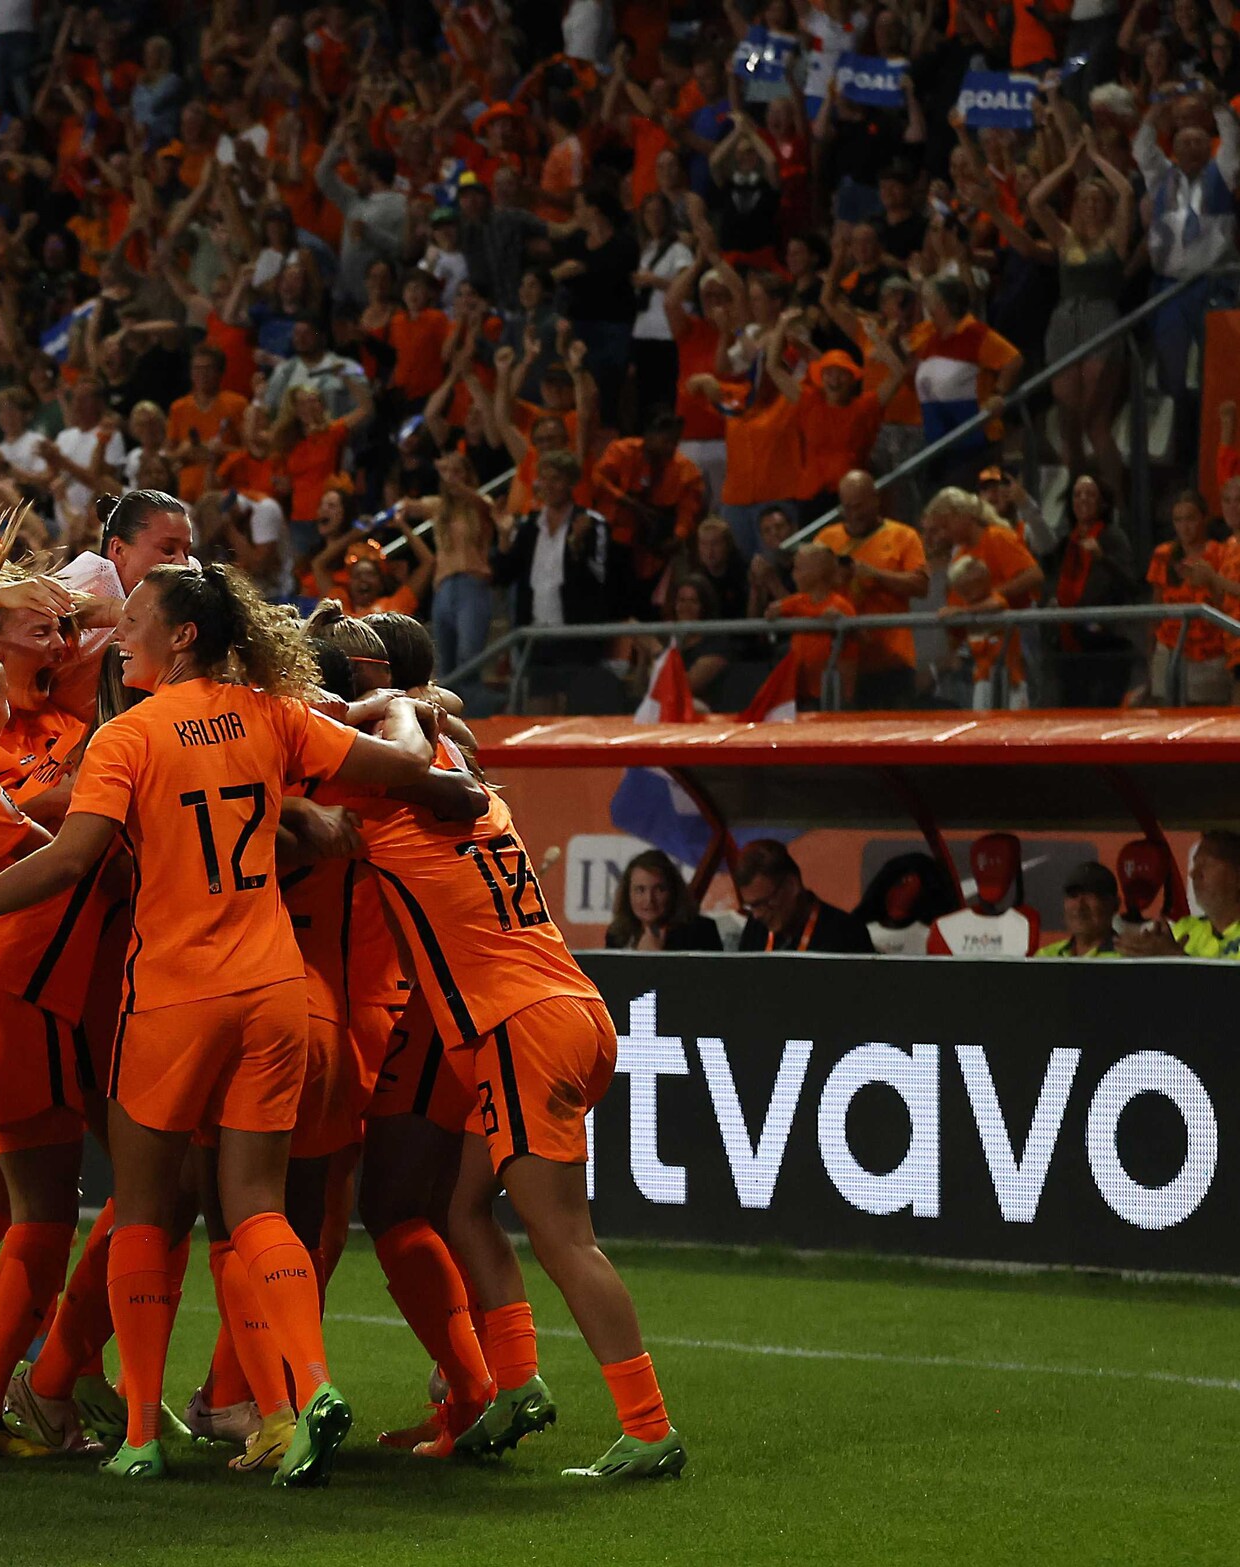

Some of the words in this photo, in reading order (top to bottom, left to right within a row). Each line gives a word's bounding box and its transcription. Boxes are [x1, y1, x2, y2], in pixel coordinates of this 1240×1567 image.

[173, 711, 246, 747] KALMA
[179, 782, 267, 894] 12
[585, 989, 1218, 1230] tvavo
